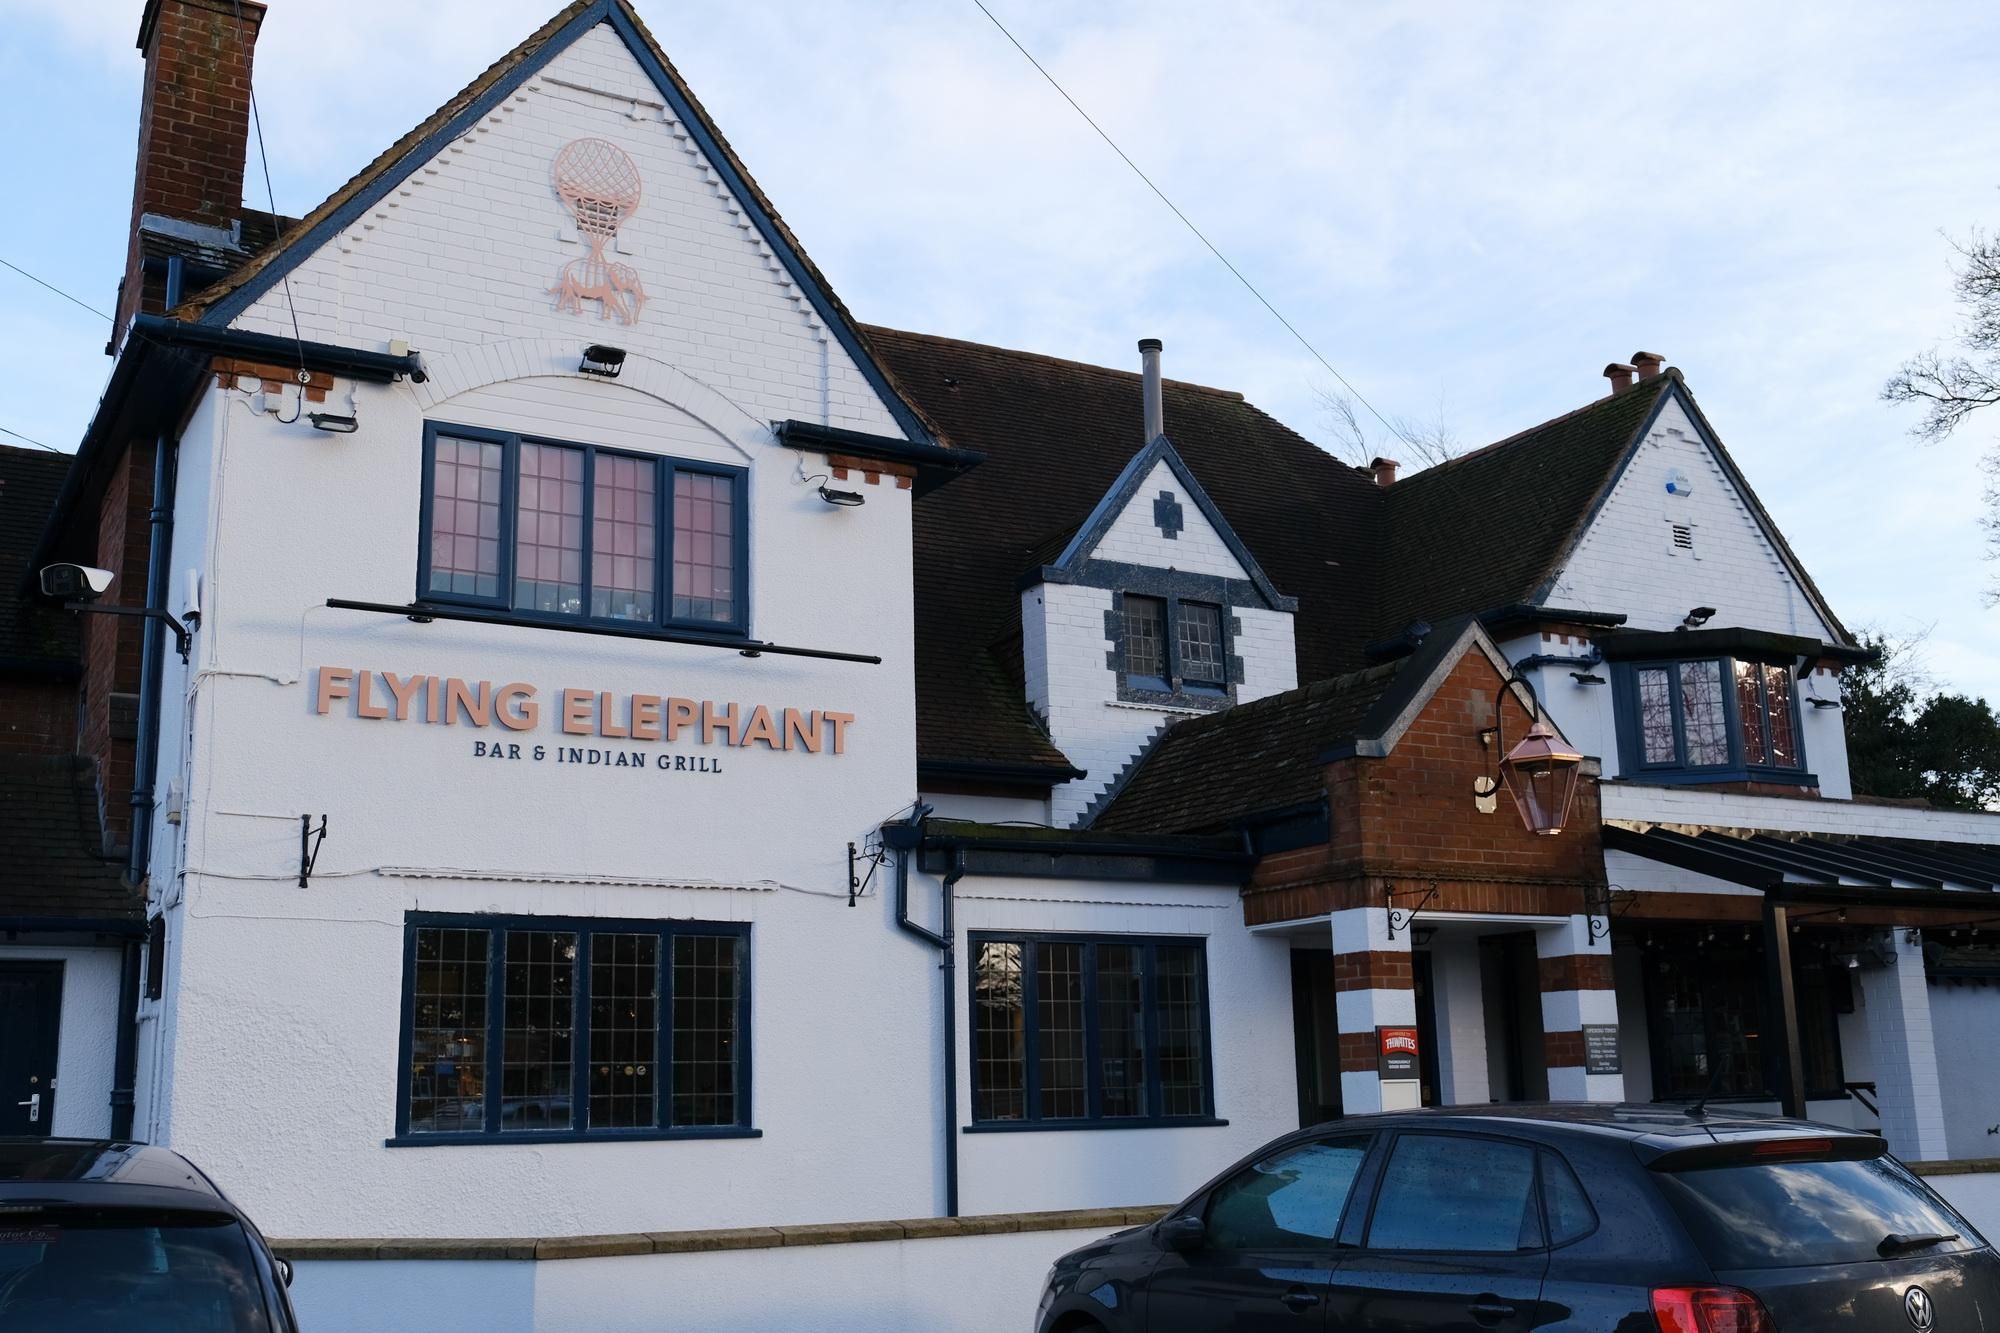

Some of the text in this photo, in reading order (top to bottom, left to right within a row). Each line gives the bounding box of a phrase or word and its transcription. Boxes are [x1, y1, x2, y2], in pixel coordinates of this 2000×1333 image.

[317, 666, 855, 754] FLYING ELEPHANT
[474, 741, 723, 773] BAR & INDIAN GRILL
